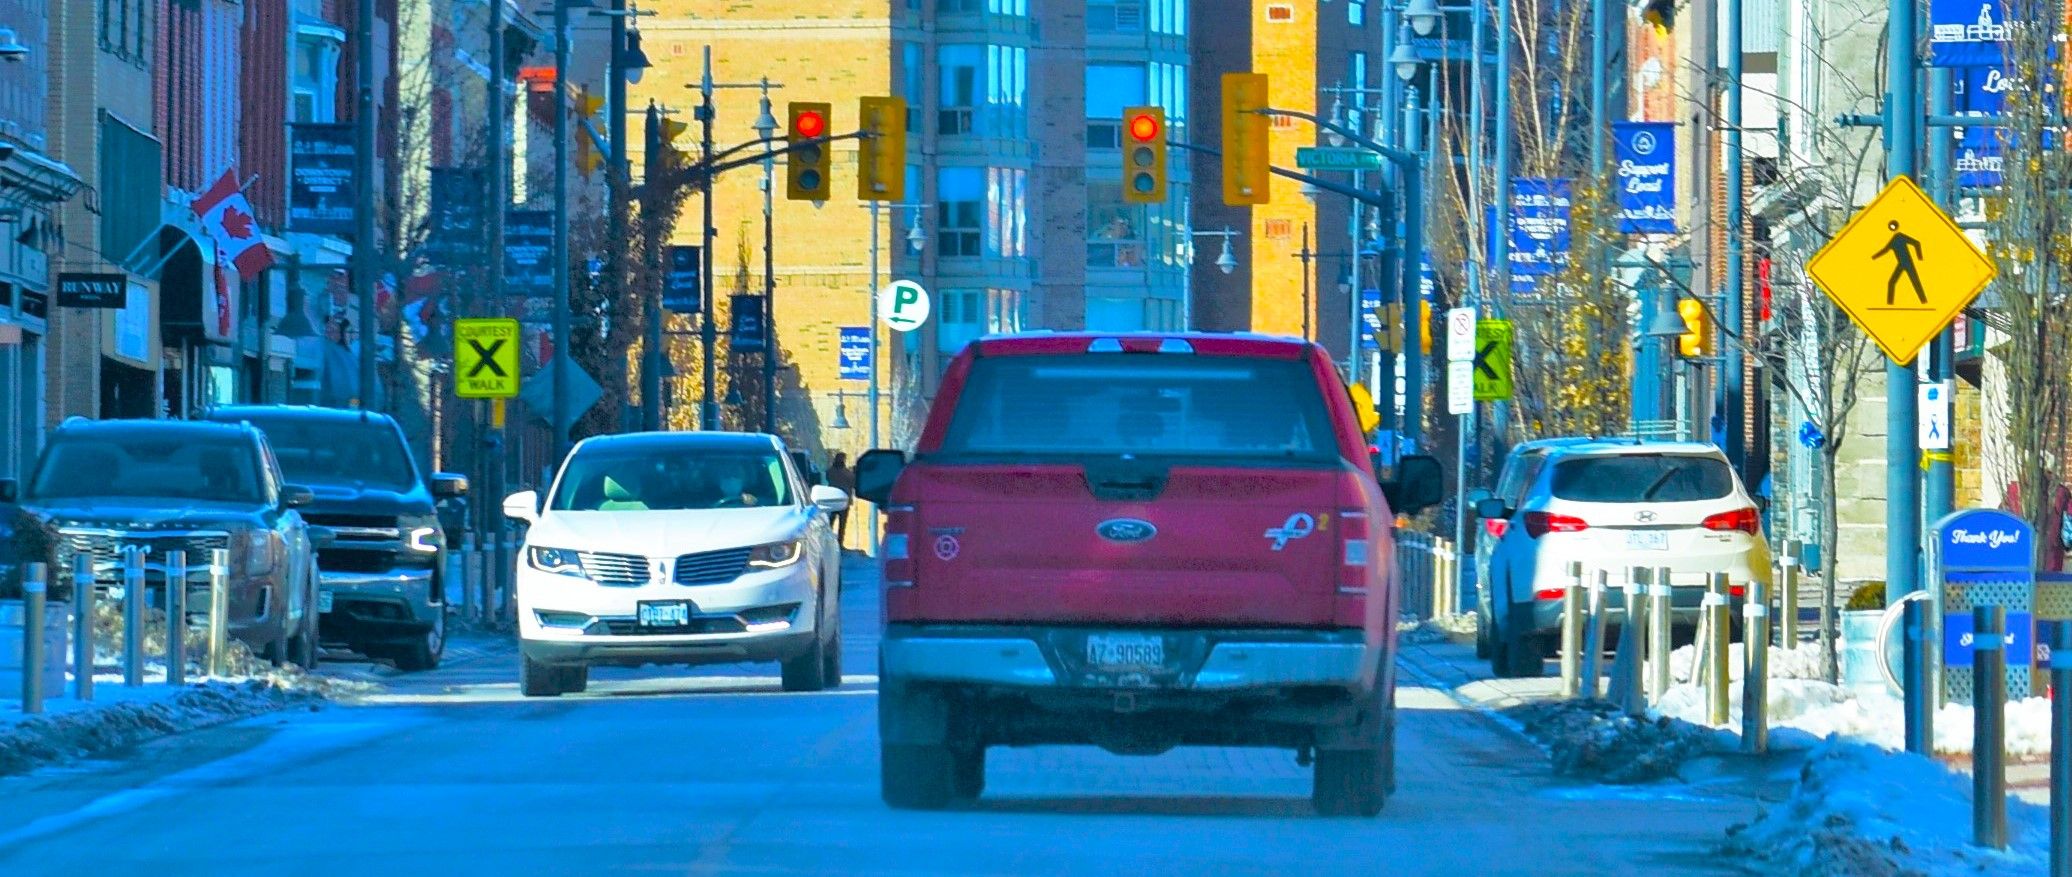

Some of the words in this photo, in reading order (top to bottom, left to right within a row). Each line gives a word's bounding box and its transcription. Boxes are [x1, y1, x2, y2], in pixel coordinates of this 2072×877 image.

[1298, 150, 1358, 166] VICTORIA
[1618, 159, 1670, 177] Support
[1625, 176, 1663, 194] Local
[62, 281, 120, 294] RUNWAY
[894, 286, 919, 314] P
[460, 326, 512, 337] COURTESY
[469, 380, 504, 390] WALK
[1109, 523, 1143, 538] Ford
[1952, 529, 1987, 544] Thank
[1988, 529, 2020, 548] You!
